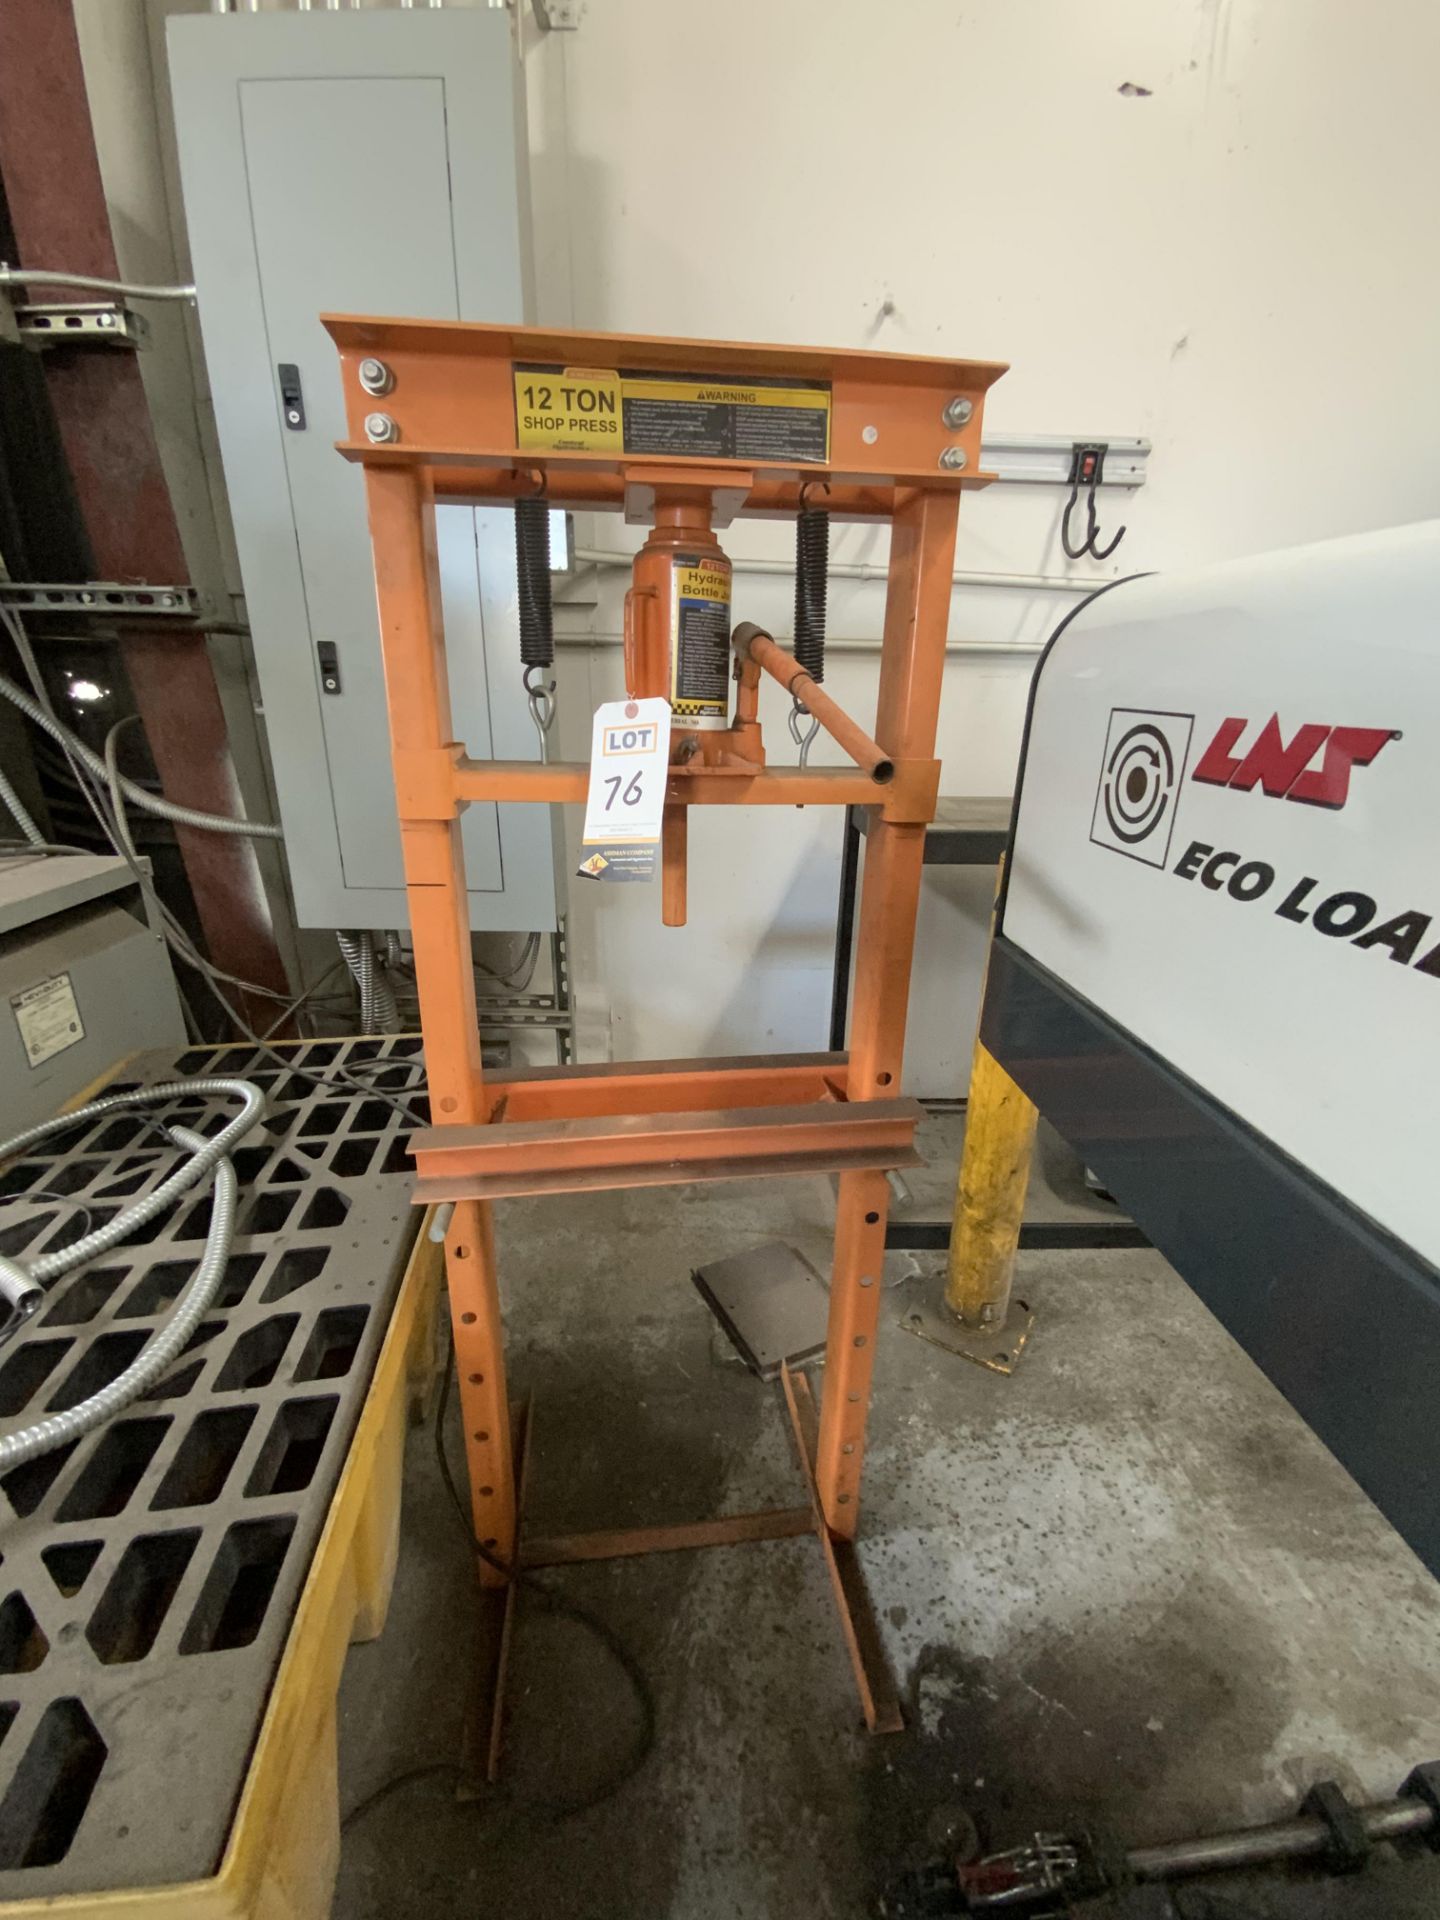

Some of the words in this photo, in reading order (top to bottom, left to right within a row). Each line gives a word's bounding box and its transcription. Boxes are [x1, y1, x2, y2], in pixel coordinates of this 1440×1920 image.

[523, 386, 552, 411] 12
[560, 388, 615, 414] TON
[705, 391, 757, 403] WARNING
[523, 416, 565, 431] SHOP
[569, 418, 618, 434] PRESS
[682, 584, 719, 599] Bottle
[609, 729, 652, 750] LOT
[1192, 712, 1394, 811] LNS
[604, 770, 643, 811] 76
[1173, 841, 1275, 901] ECO
